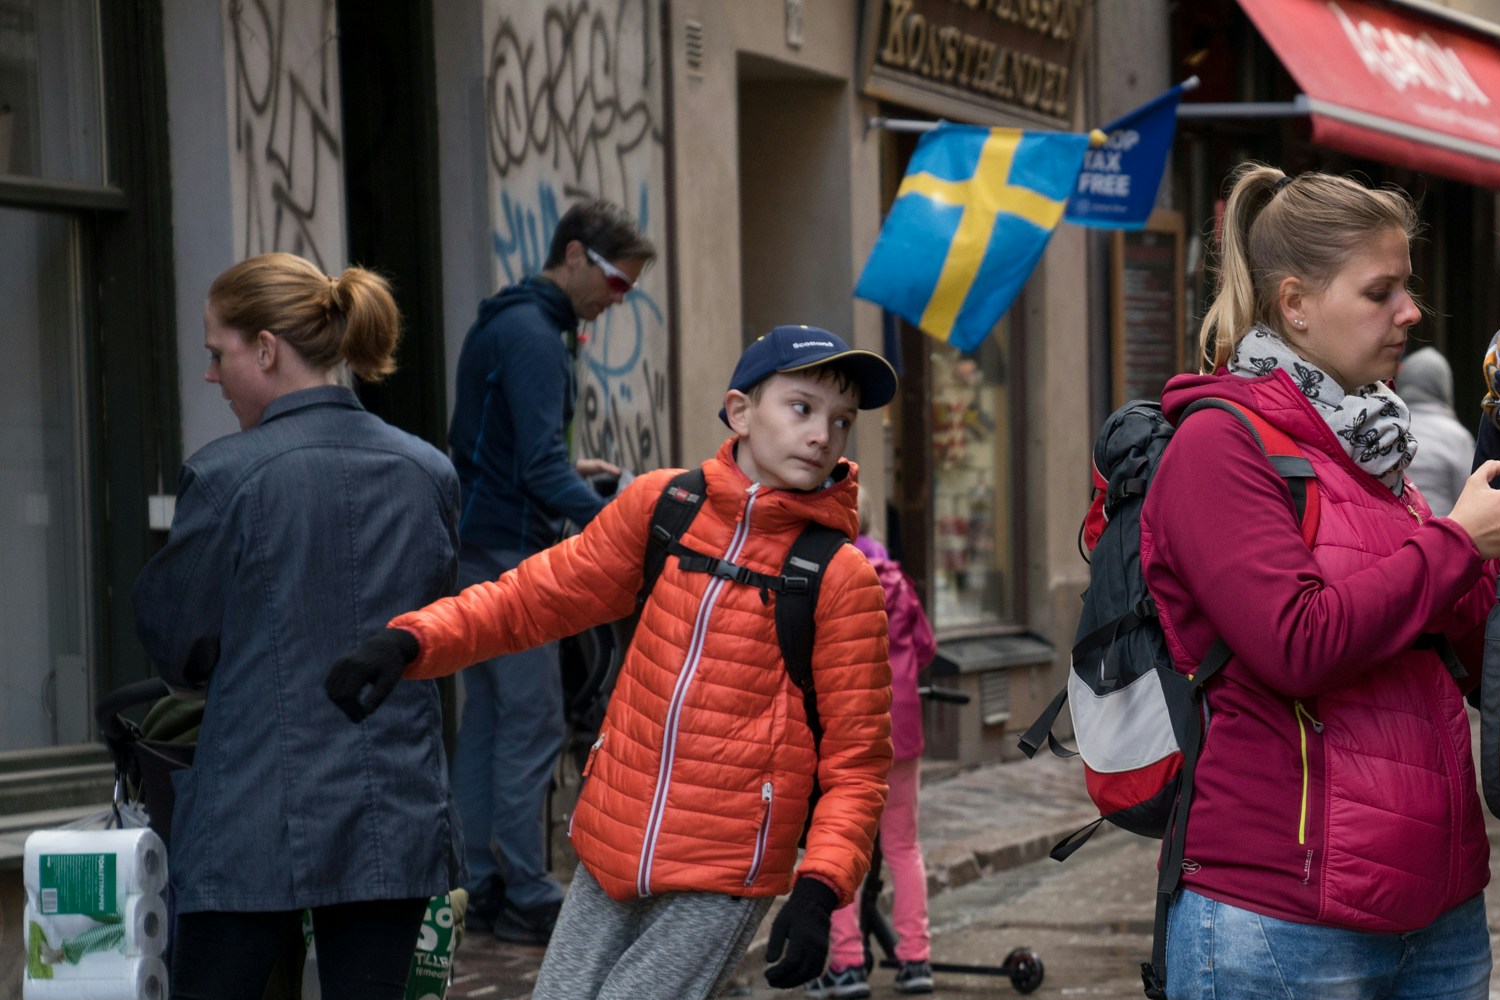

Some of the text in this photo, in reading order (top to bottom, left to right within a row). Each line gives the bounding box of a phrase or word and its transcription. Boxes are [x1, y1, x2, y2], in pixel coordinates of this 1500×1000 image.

[881, 0, 1069, 114] KONSTHANDEL
[1084, 150, 1122, 172] TAX
[1078, 172, 1131, 197] FREE
